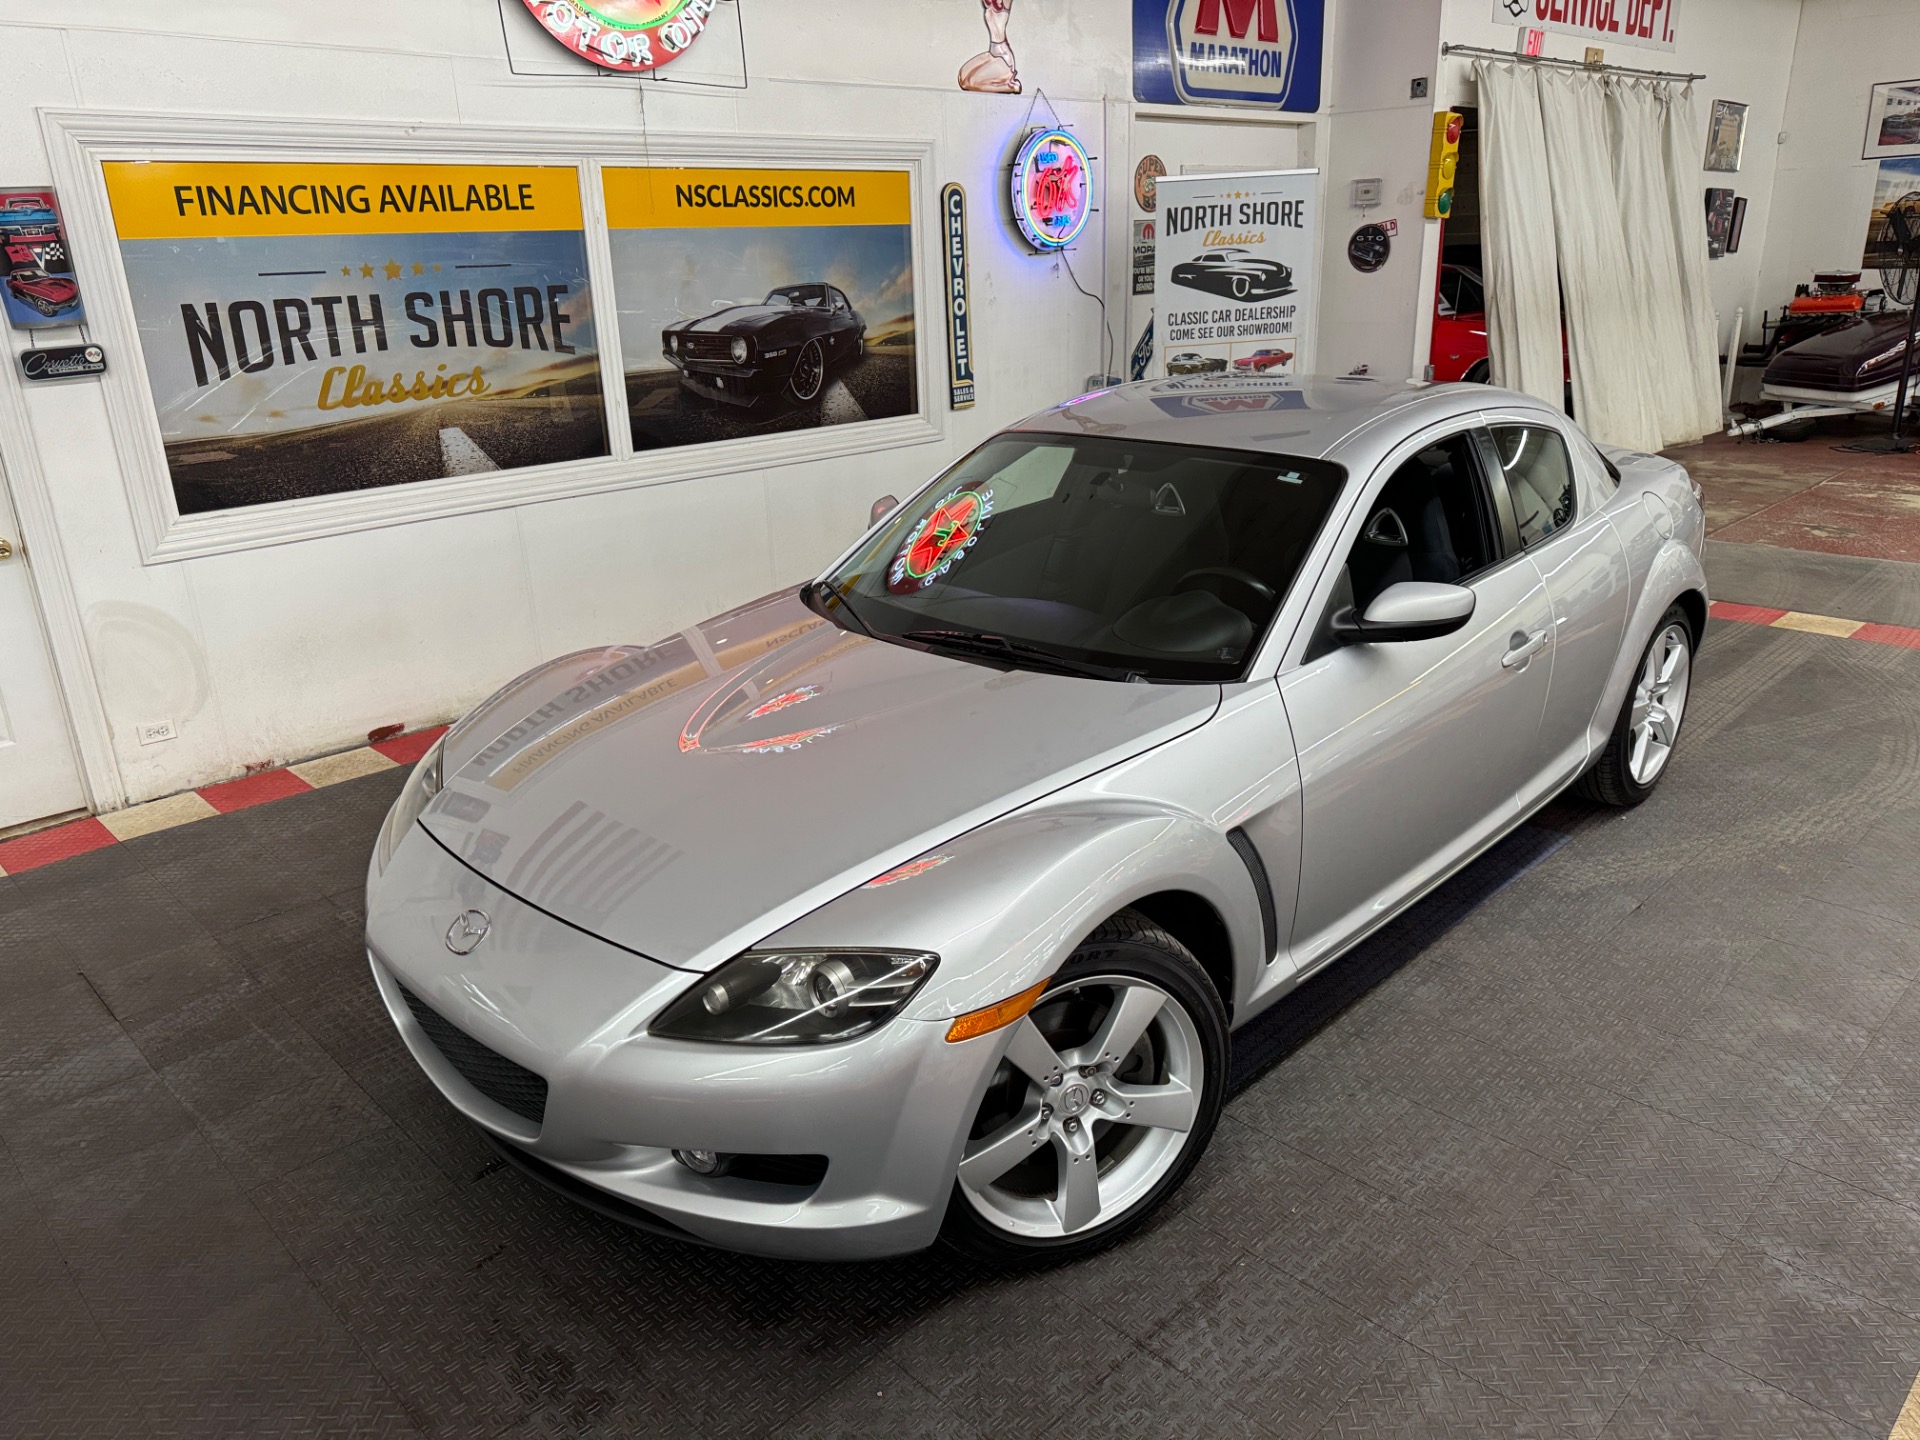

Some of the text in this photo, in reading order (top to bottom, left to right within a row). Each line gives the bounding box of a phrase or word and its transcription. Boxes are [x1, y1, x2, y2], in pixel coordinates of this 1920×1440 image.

[1526, 29, 1545, 57] EXIT
[1188, 42, 1282, 78] MARATHON
[174, 183, 536, 217] FINANCING AVAILABLE
[675, 184, 855, 208] NSCLASSICS.COM
[1142, 194, 1156, 209] BE
[1165, 200, 1305, 237] NORTH SHORE
[1379, 221, 1396, 232] OLD
[1202, 229, 1267, 247] Classics
[1133, 246, 1154, 254] MOPA
[949, 194, 968, 377] CHEVROLET
[1168, 305, 1296, 326] CLASSIC CAR DEALERSHIP
[180, 284, 577, 388] NORTH SHORE
[1169, 321, 1293, 341] COME SEE OUR SHOWROOM!
[25, 353, 89, 376] Corvette
[316, 362, 493, 411] Classics
[1069, 950, 1118, 964] ORT
